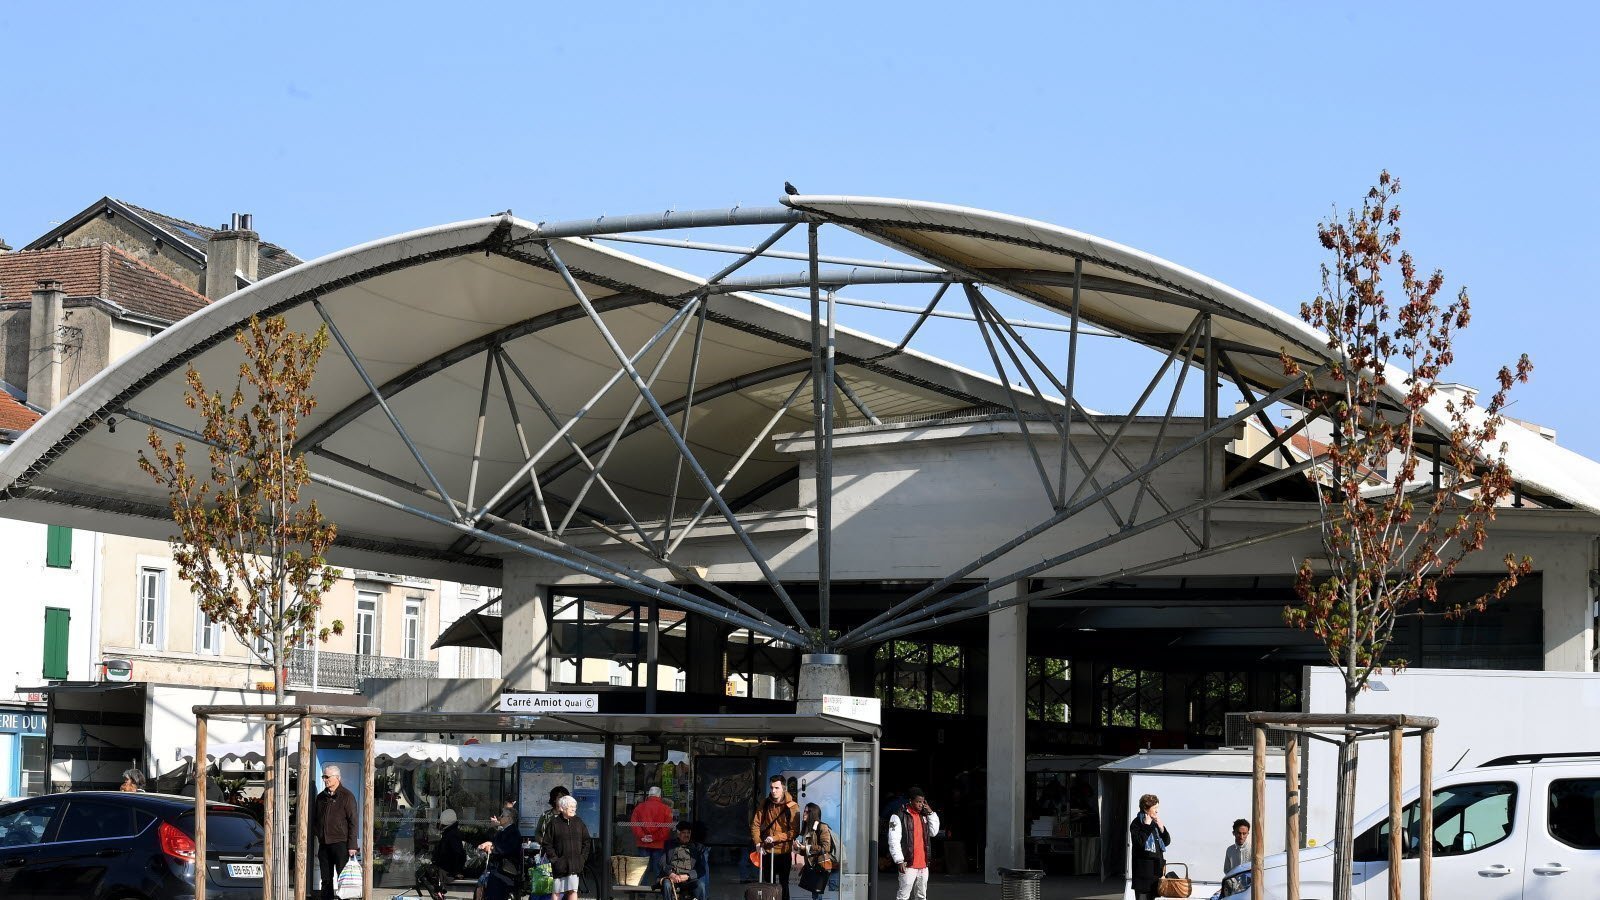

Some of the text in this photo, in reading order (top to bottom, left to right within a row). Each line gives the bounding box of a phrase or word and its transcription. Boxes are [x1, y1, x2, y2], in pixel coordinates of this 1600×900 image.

[507, 697, 531, 707] Carré
[534, 697, 562, 707] Amiot
[564, 699, 582, 707] Quai
[22, 716, 38, 730] DU
